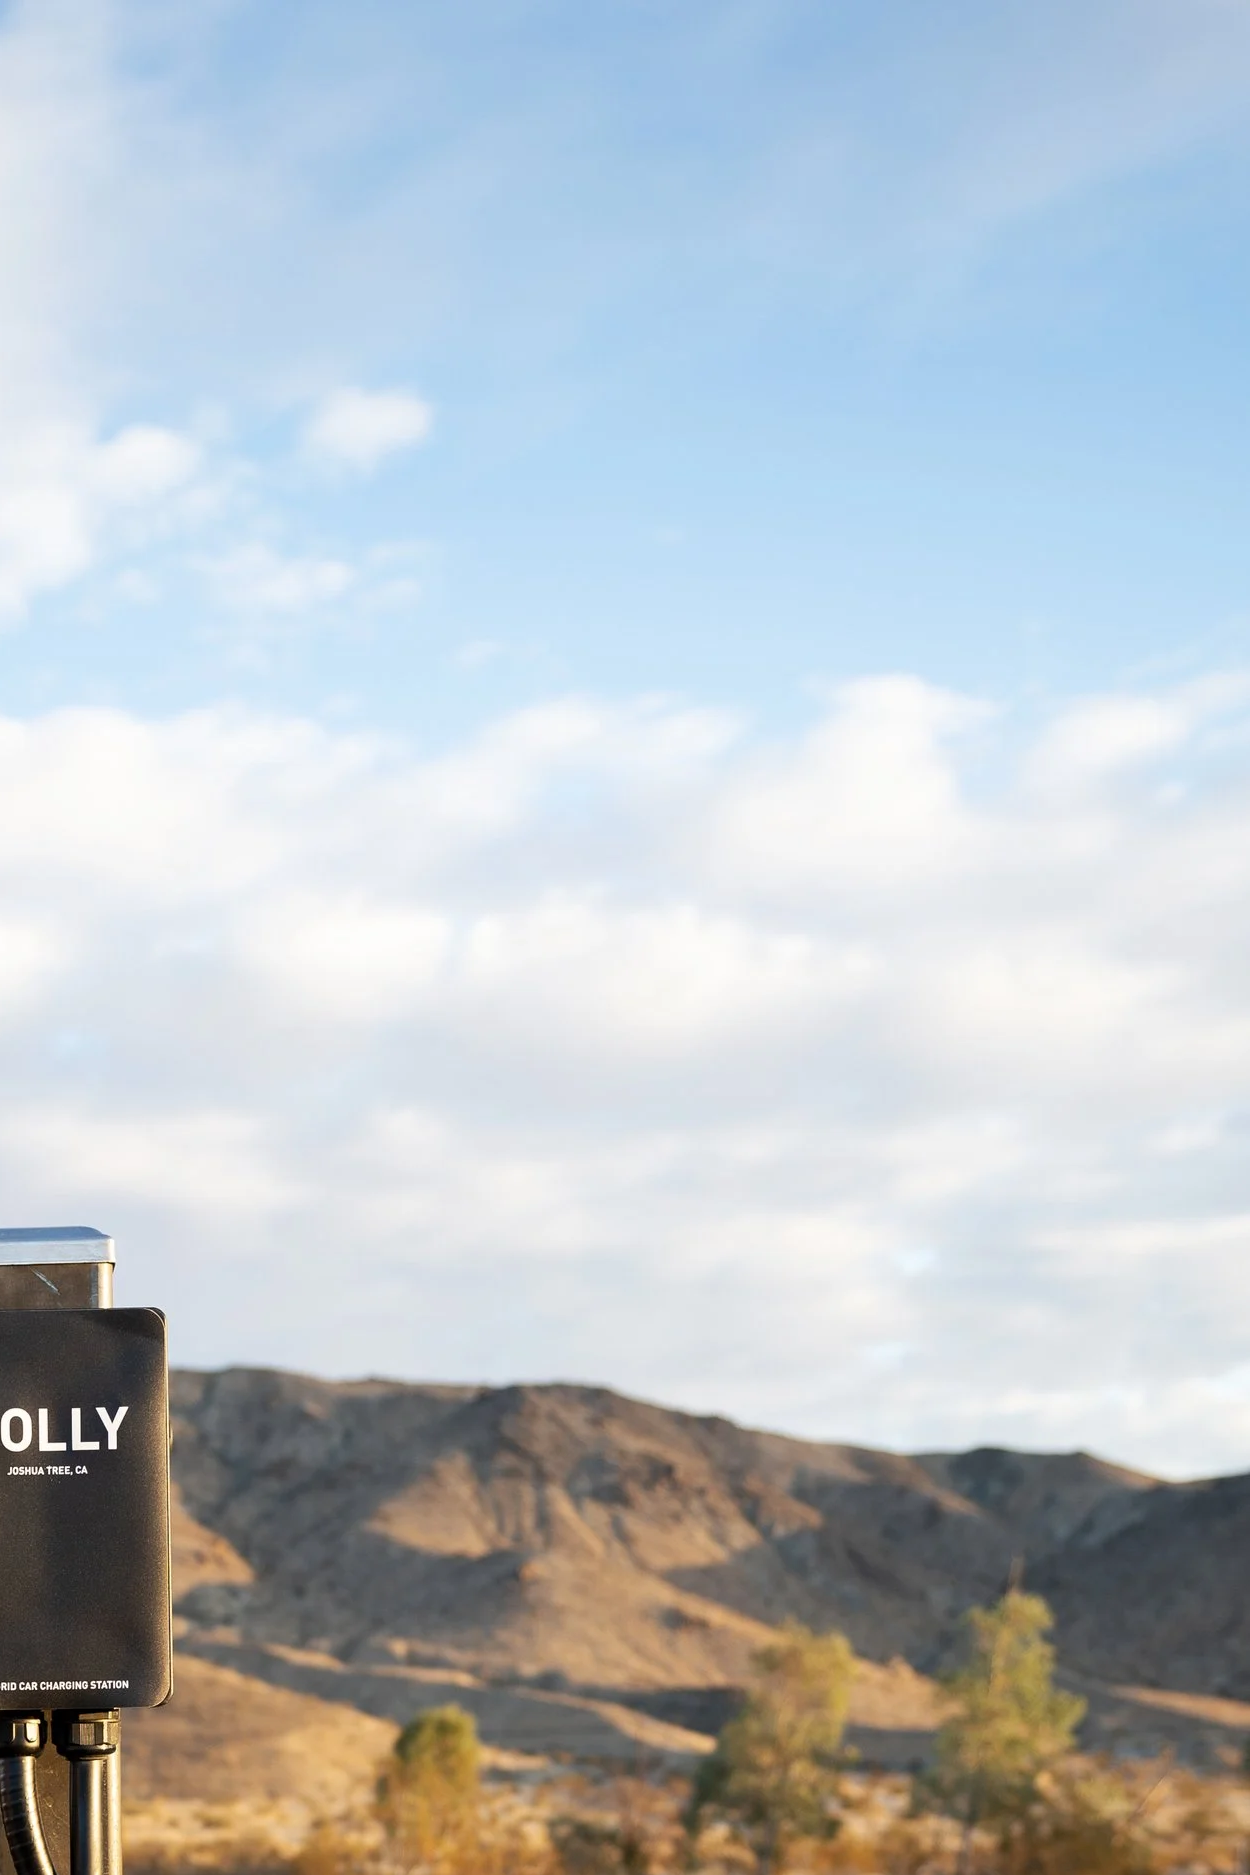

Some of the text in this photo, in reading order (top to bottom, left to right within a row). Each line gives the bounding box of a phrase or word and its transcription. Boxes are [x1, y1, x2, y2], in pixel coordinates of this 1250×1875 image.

[7, 1465, 88, 1476] JOSHUA TREE, CA
[19, 1681, 38, 1691] CAR
[39, 1681, 89, 1690] CHARGING
[90, 1680, 130, 1690] STATION
